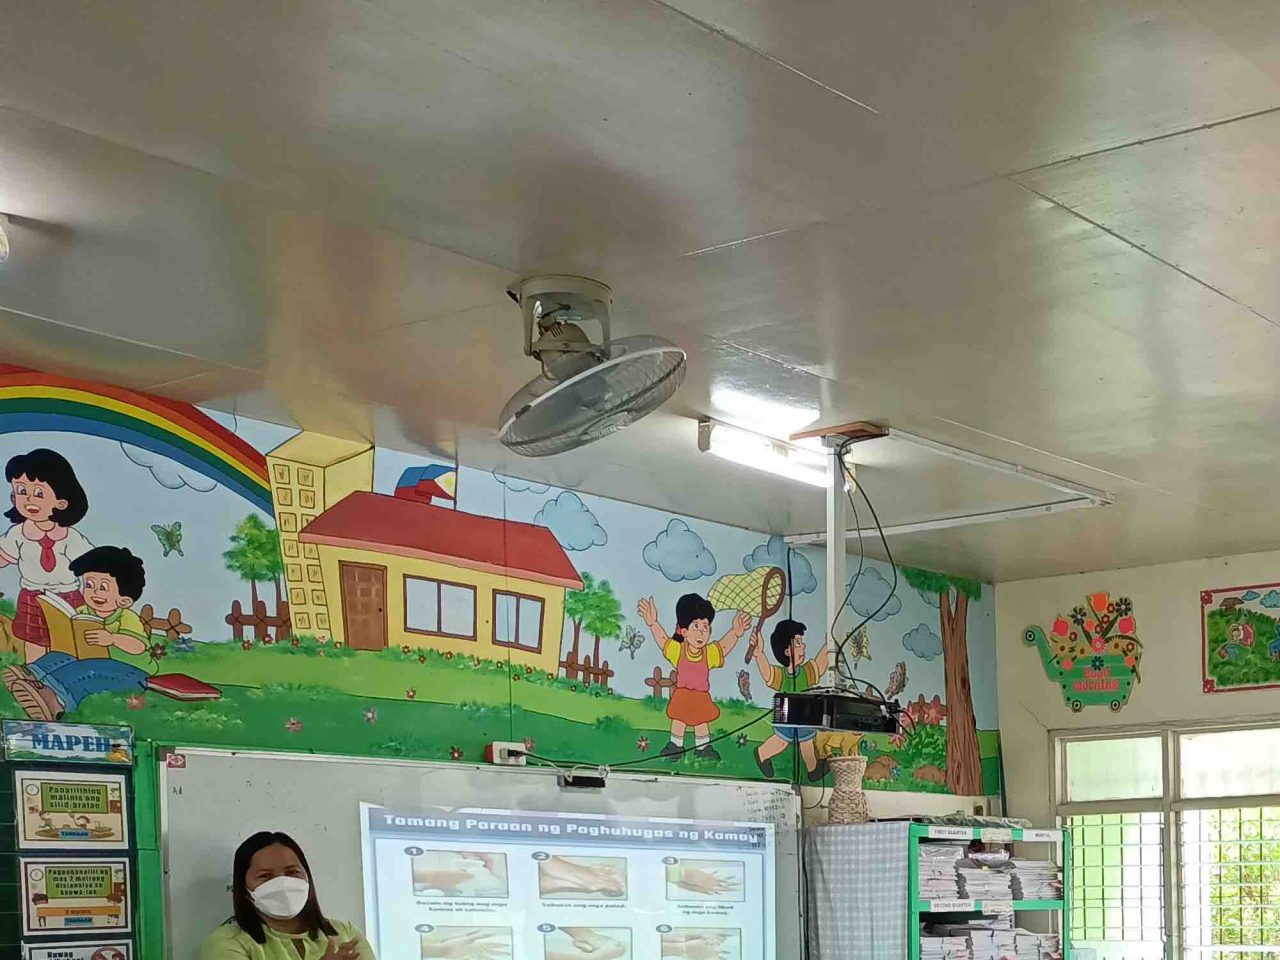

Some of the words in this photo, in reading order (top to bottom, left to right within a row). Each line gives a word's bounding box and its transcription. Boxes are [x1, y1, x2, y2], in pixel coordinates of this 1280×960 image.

[31, 733, 111, 752] MAPEH
[384, 814, 460, 830] Tamang
[466, 819, 532, 832] Paraan
[538, 823, 561, 835] ng
[566, 823, 674, 840] Paghuhugas
[679, 830, 699, 841] ng
[704, 830, 758, 844] Kamay
